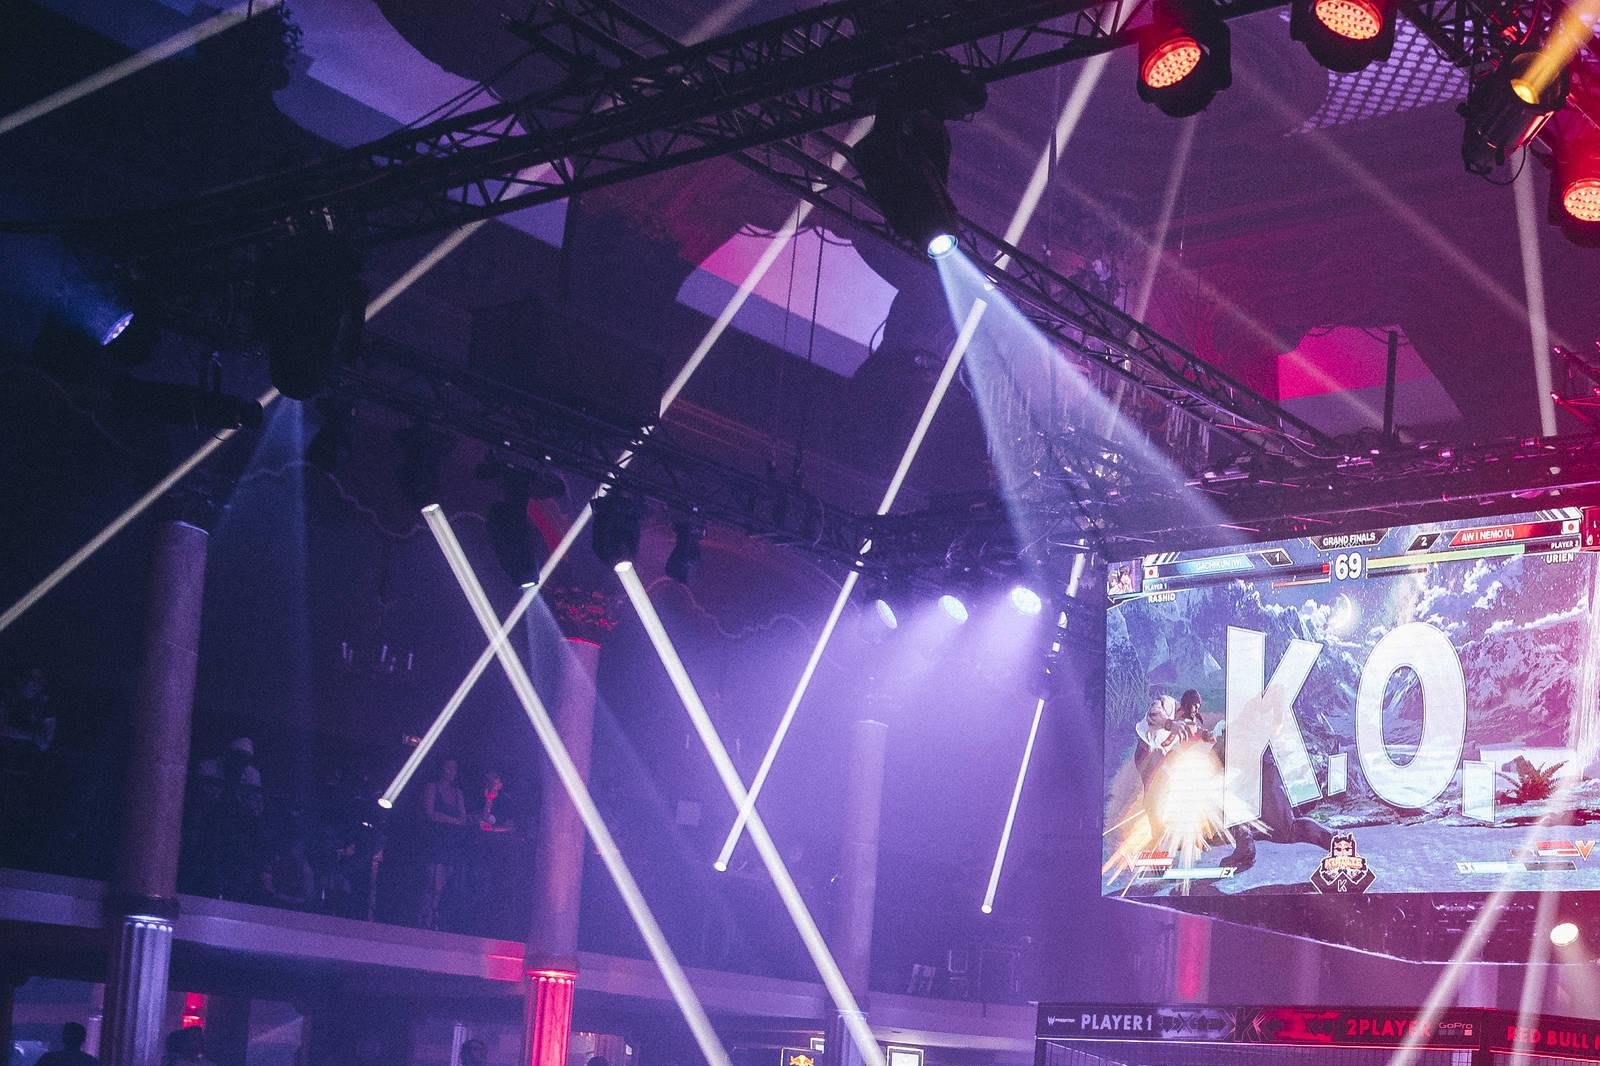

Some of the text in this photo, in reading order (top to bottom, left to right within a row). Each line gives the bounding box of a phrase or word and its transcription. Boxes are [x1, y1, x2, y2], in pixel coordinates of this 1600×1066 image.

[1323, 532, 1376, 546] GRAND FINALS
[1480, 530, 1504, 540] NEMO
[1421, 537, 1428, 547] 2
[1546, 553, 1574, 564] URIEN
[1335, 552, 1362, 581] 69
[1224, 621, 1496, 829] K.O.
[1438, 1022, 1473, 1030] GoPro
[1507, 1025, 1541, 1044] RED
[1546, 1030, 1590, 1050] BULL
